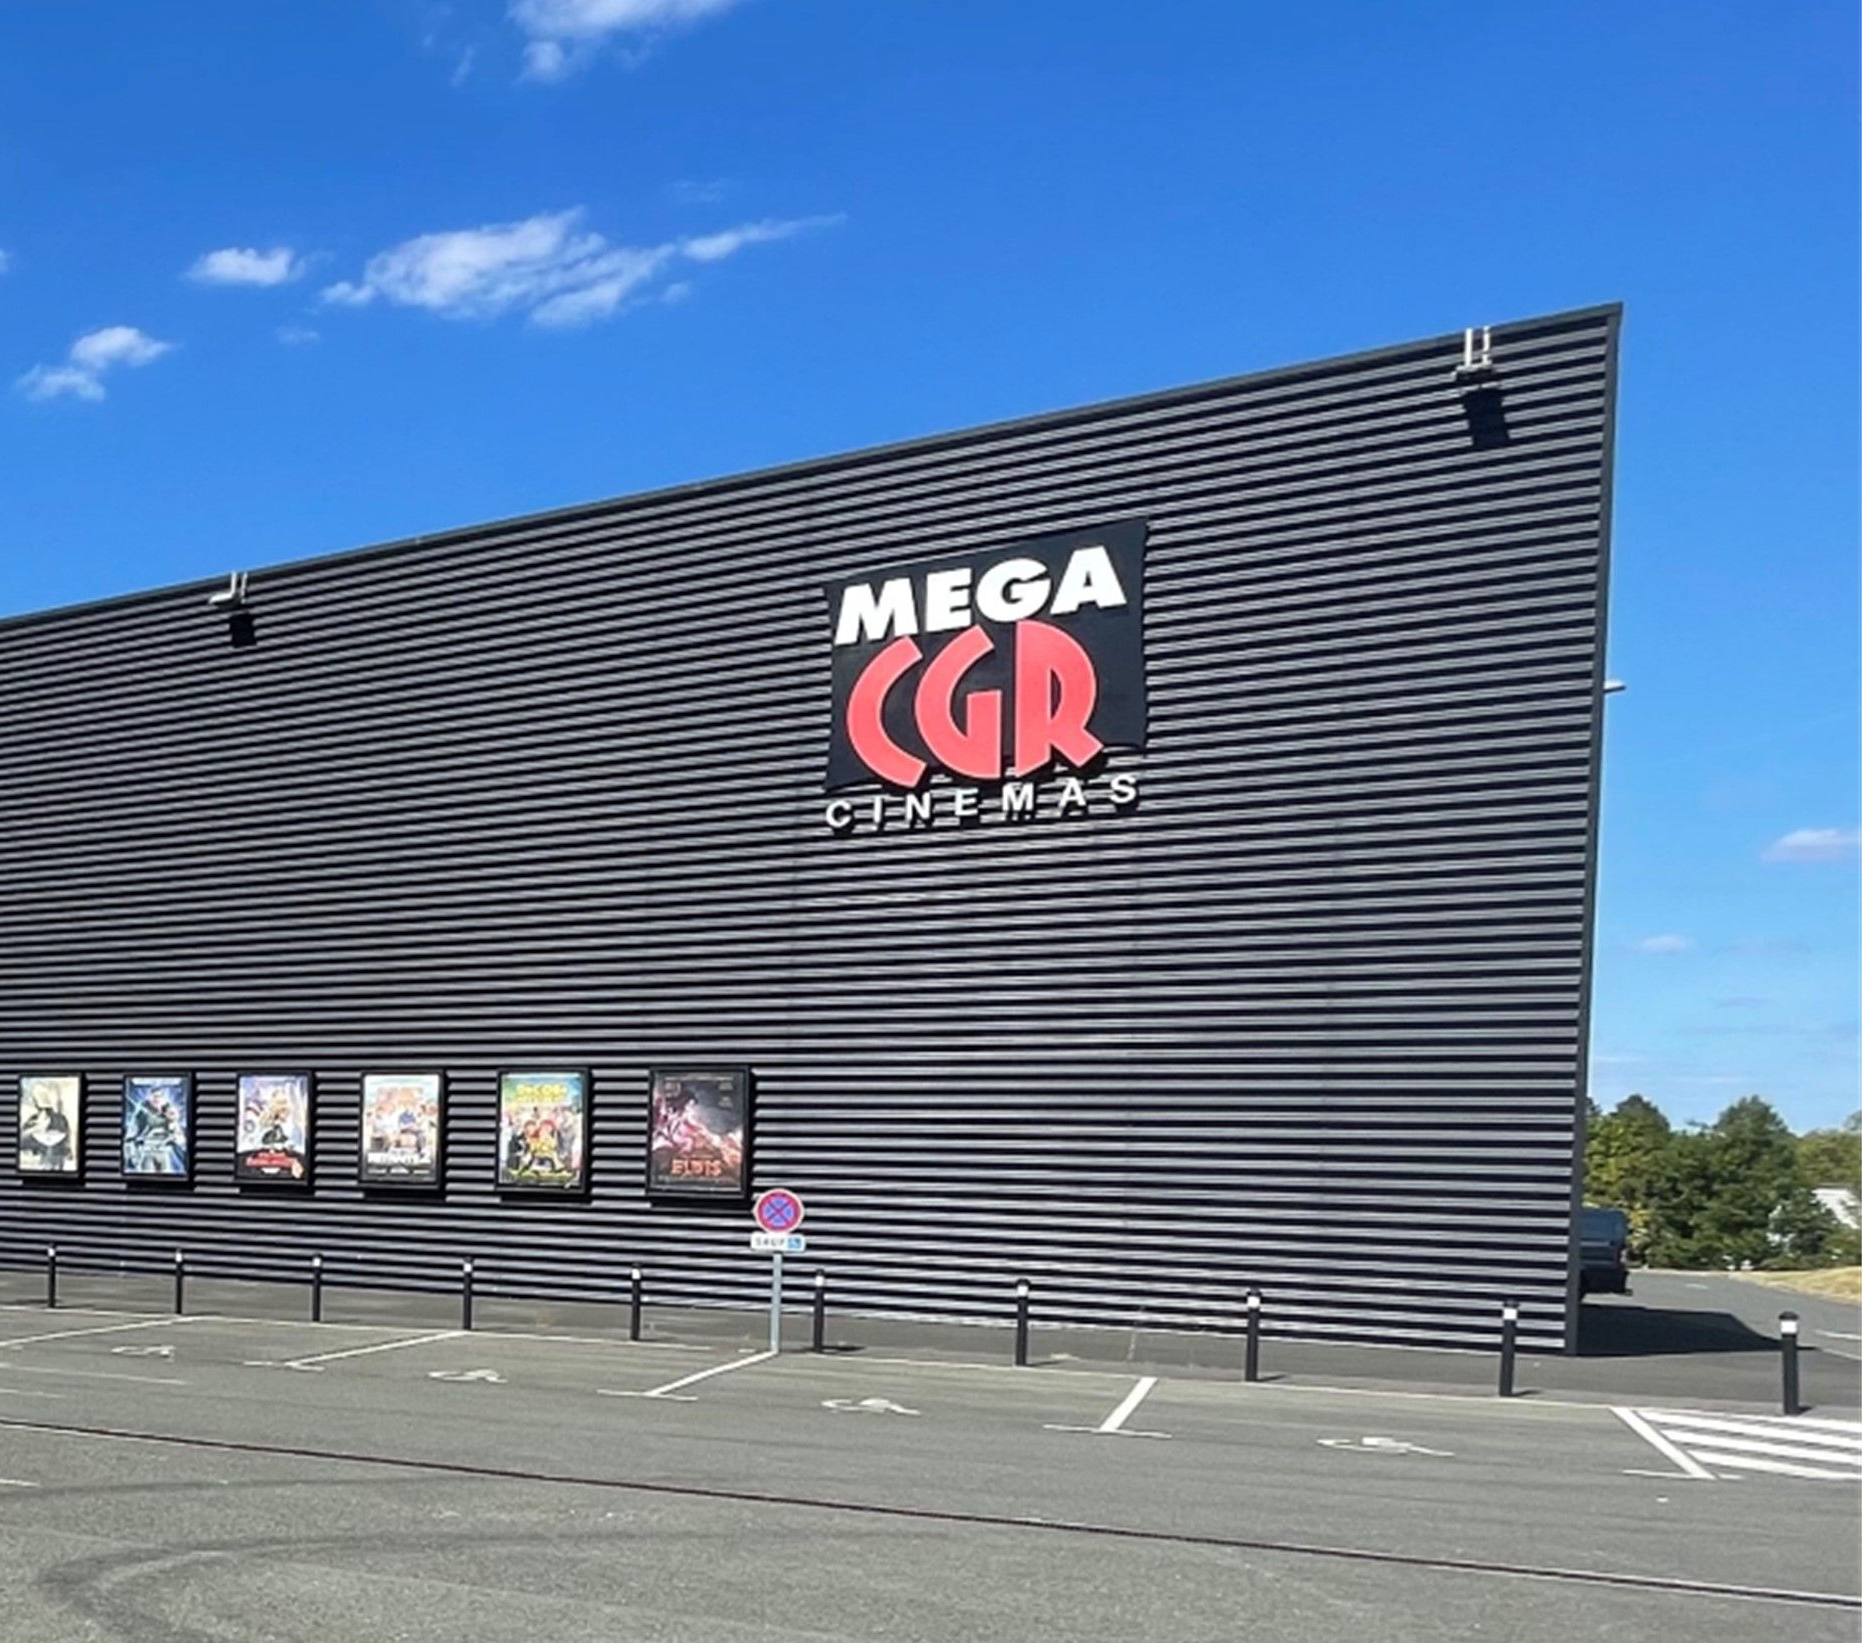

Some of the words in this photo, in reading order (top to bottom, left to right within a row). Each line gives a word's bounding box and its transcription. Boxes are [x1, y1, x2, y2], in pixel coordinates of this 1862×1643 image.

[835, 545, 1127, 646] MEGA
[846, 618, 1105, 788] CGR
[825, 773, 1137, 829] CINEMAS
[670, 1159, 722, 1177] ELVIS
